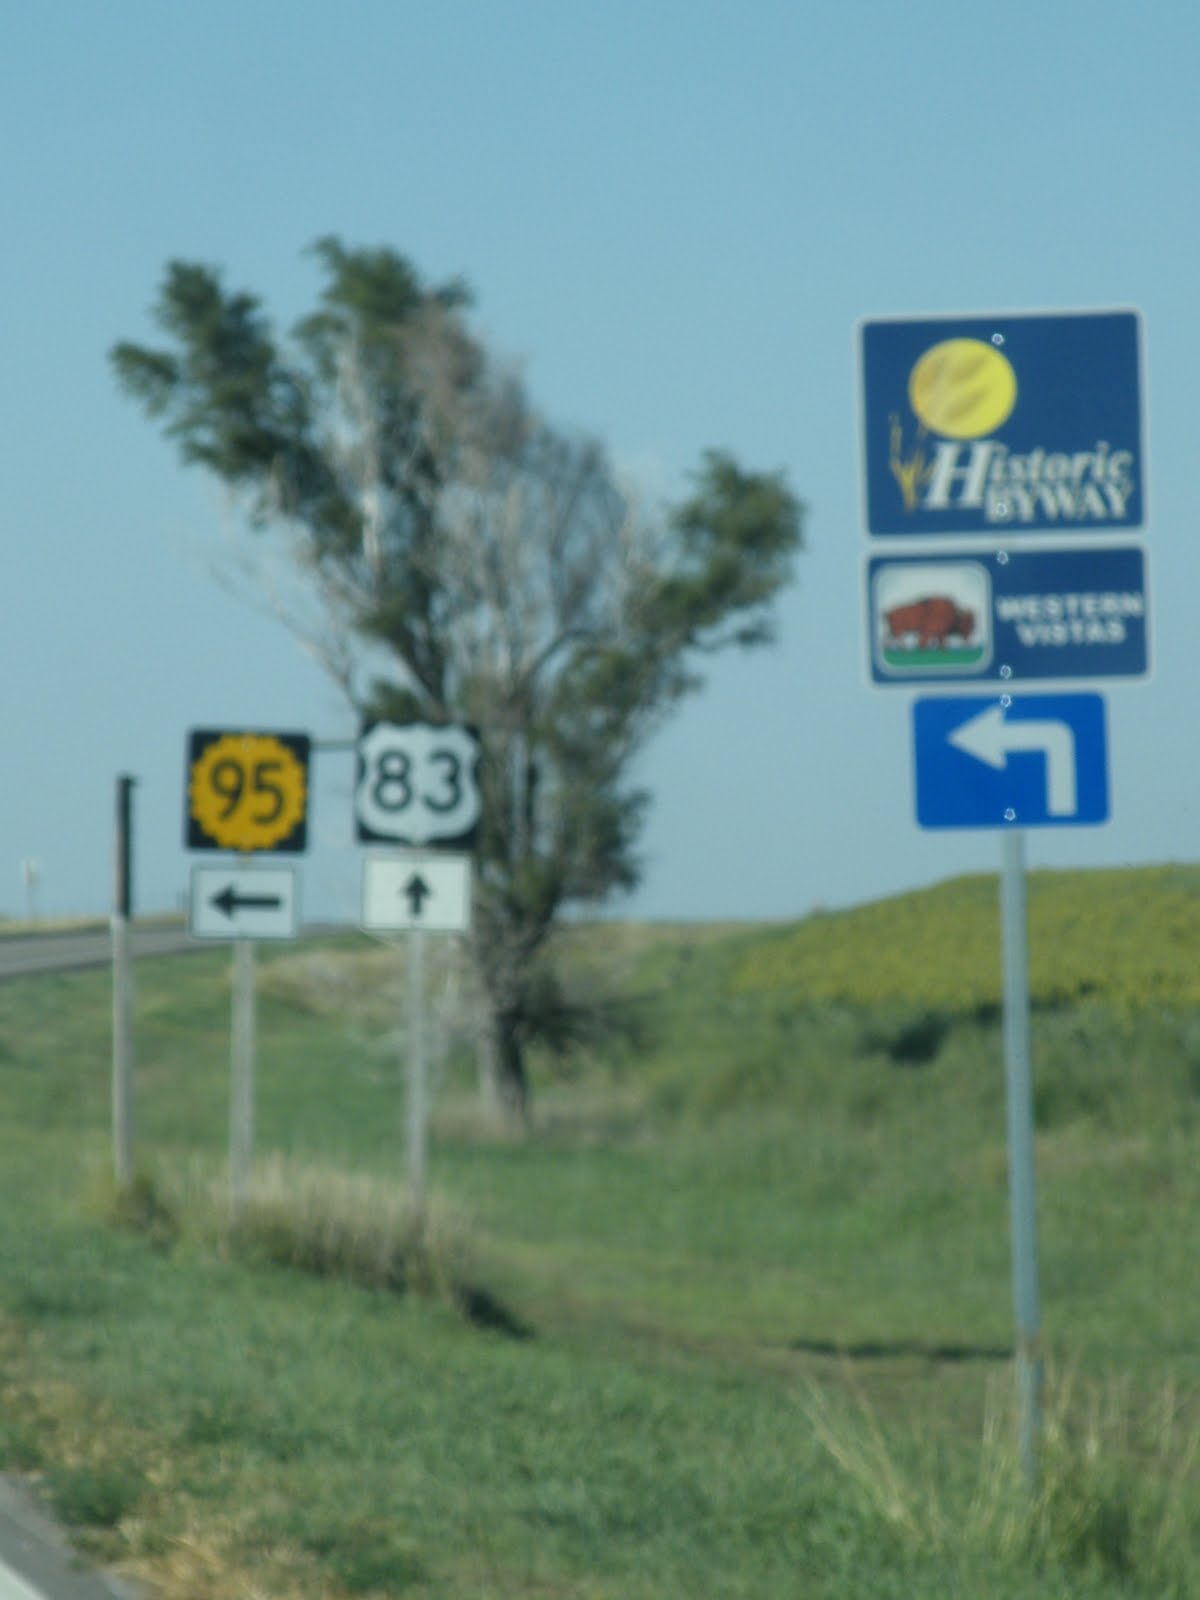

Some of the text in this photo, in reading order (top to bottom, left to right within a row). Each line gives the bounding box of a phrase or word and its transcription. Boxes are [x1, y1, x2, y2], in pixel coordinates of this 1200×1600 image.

[924, 440, 1134, 509] Historic
[986, 481, 1134, 522] BYWAY
[998, 593, 1142, 620] WESTERN
[1017, 620, 1126, 647] VISTAS
[210, 759, 283, 825] 95
[374, 750, 461, 813] 83
